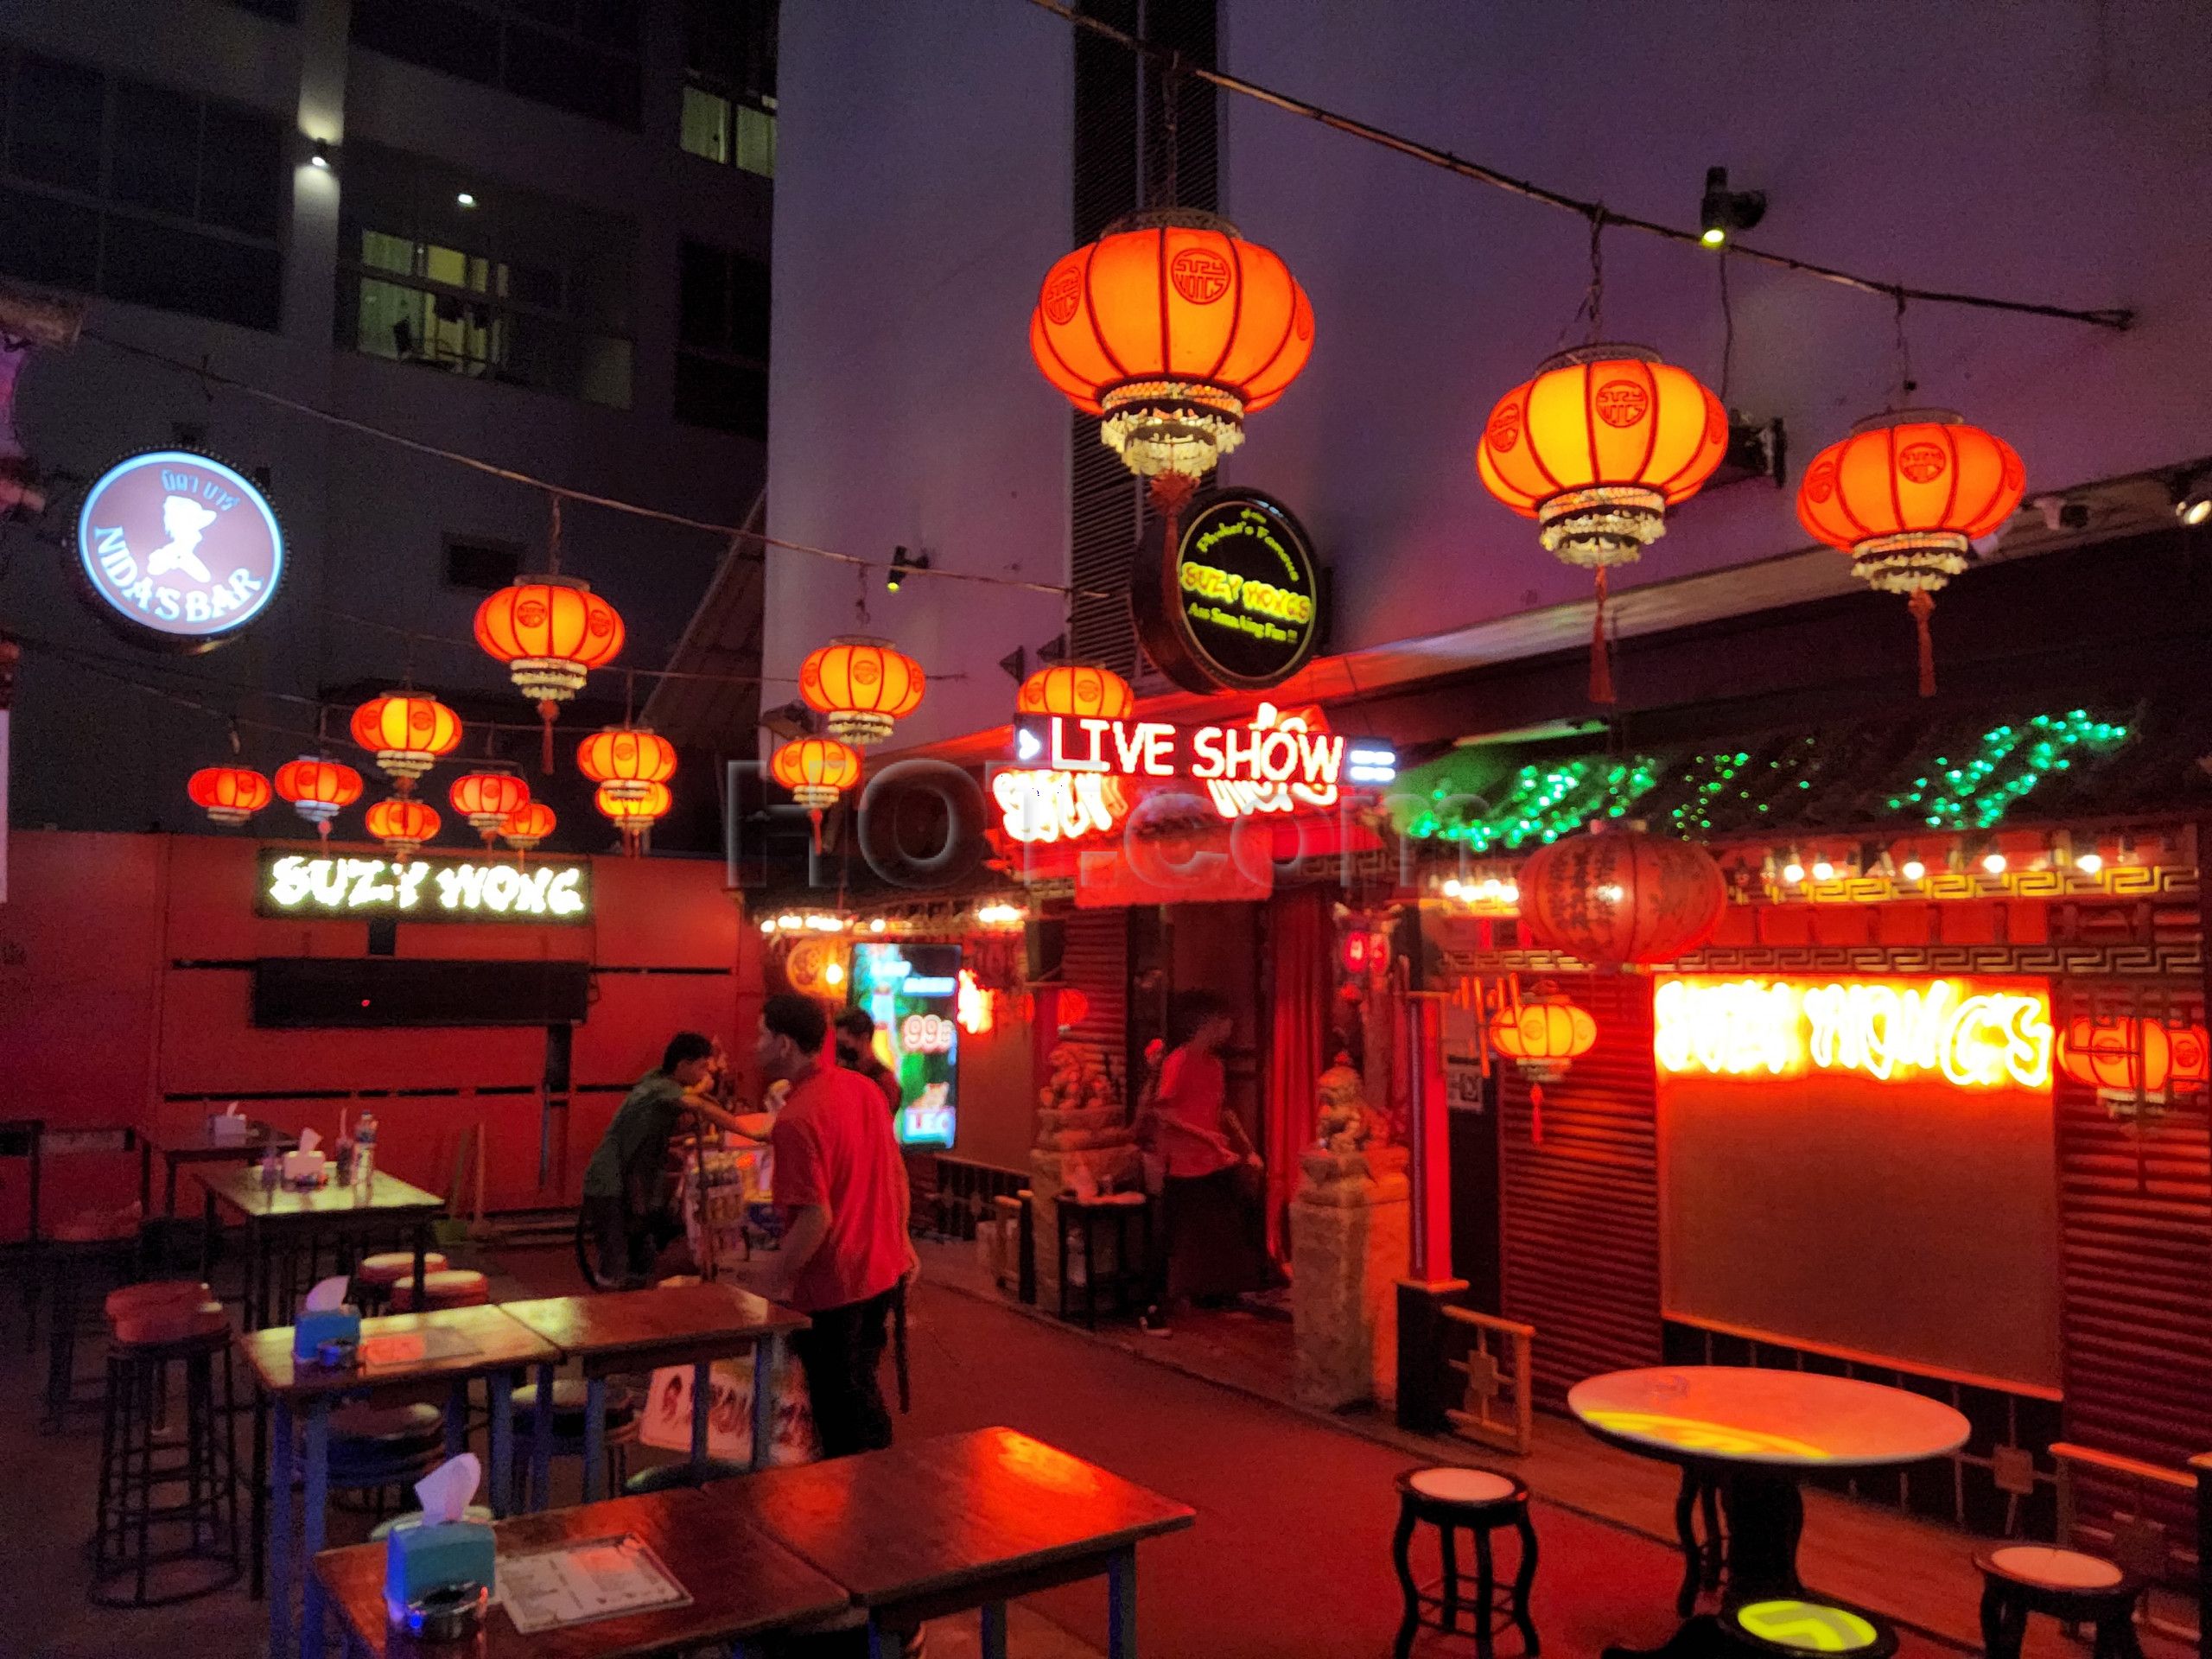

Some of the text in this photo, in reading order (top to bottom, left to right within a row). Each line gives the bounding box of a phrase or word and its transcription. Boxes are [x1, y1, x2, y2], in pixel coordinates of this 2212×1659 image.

[186, 567, 264, 622] BAR
[1181, 562, 1244, 604] SUZY
[1051, 715, 1344, 783] LIVE SHOW
[270, 855, 585, 915] SUZY WONG
